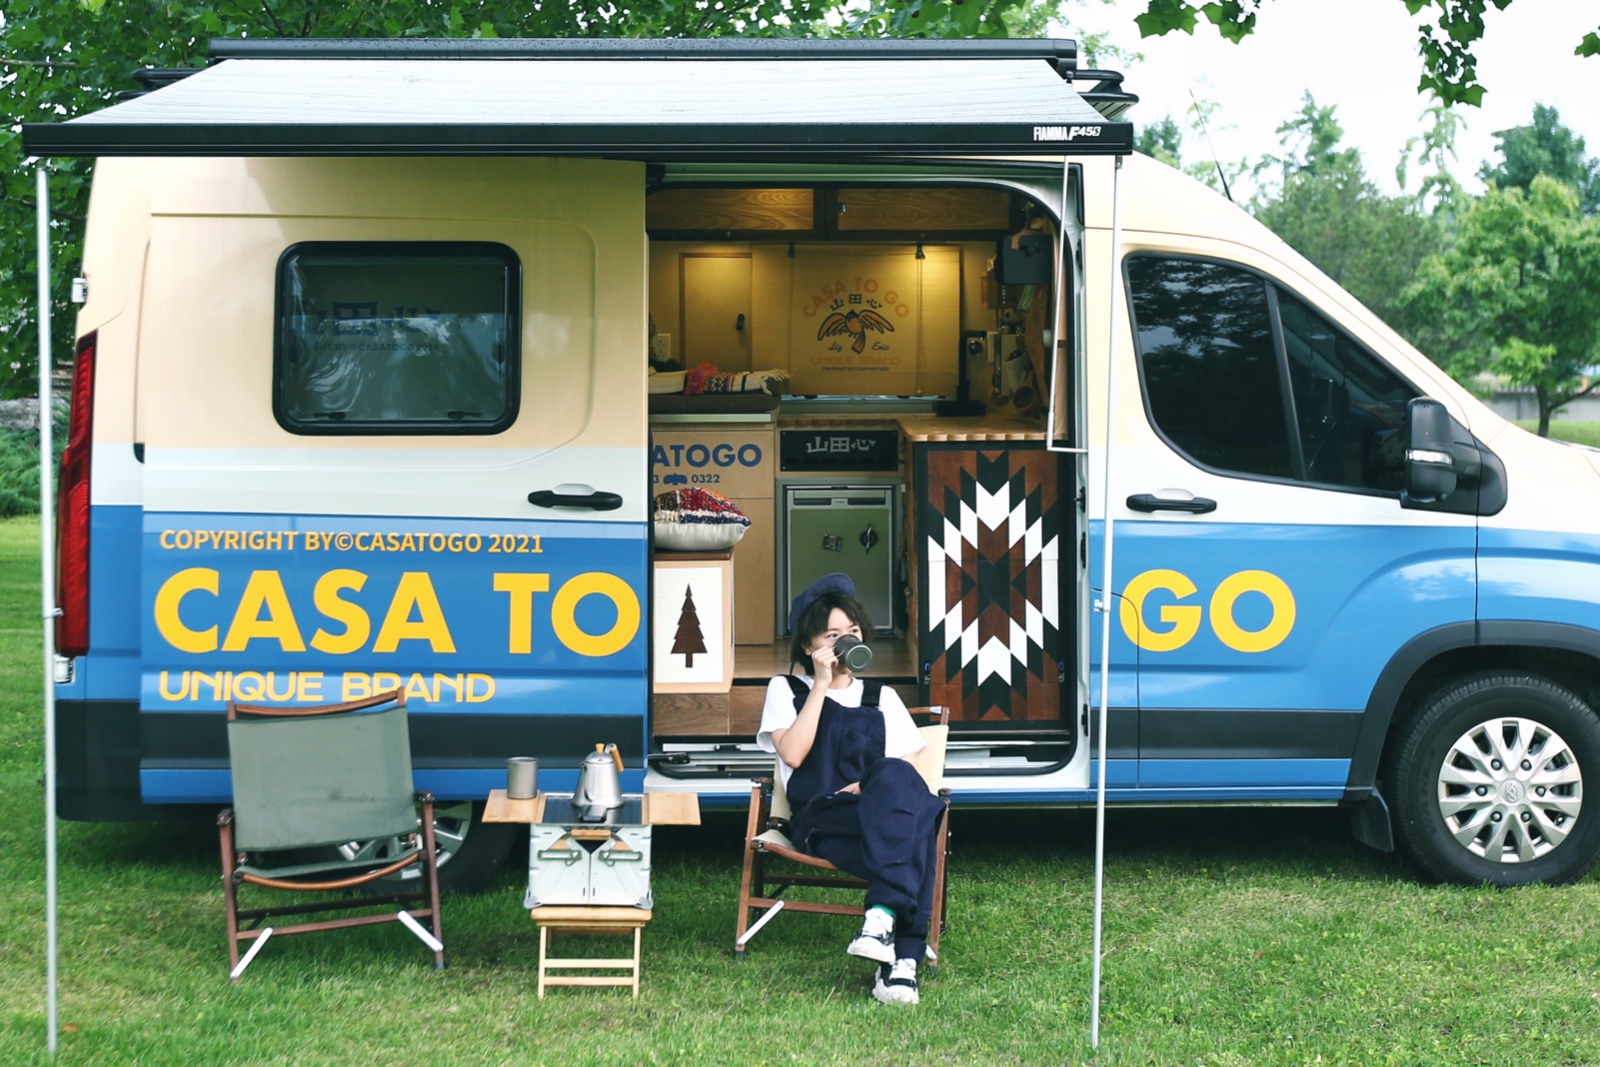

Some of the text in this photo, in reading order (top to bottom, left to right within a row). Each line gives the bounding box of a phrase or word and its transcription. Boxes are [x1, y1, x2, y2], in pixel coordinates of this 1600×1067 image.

[1033, 126, 1067, 141] FIAMMA
[803, 276, 909, 318] CASA TO GO
[829, 293, 883, 311] 山田心
[811, 356, 901, 366] UNIQUE BRAND
[806, 436, 877, 454] 山田心
[691, 474, 720, 484] 0322
[160, 529, 299, 551] COPYRIGHT
[488, 534, 544, 553] 2021
[153, 567, 1296, 657] CASA TO GO
[159, 671, 496, 703] UNIQUE BRAND
